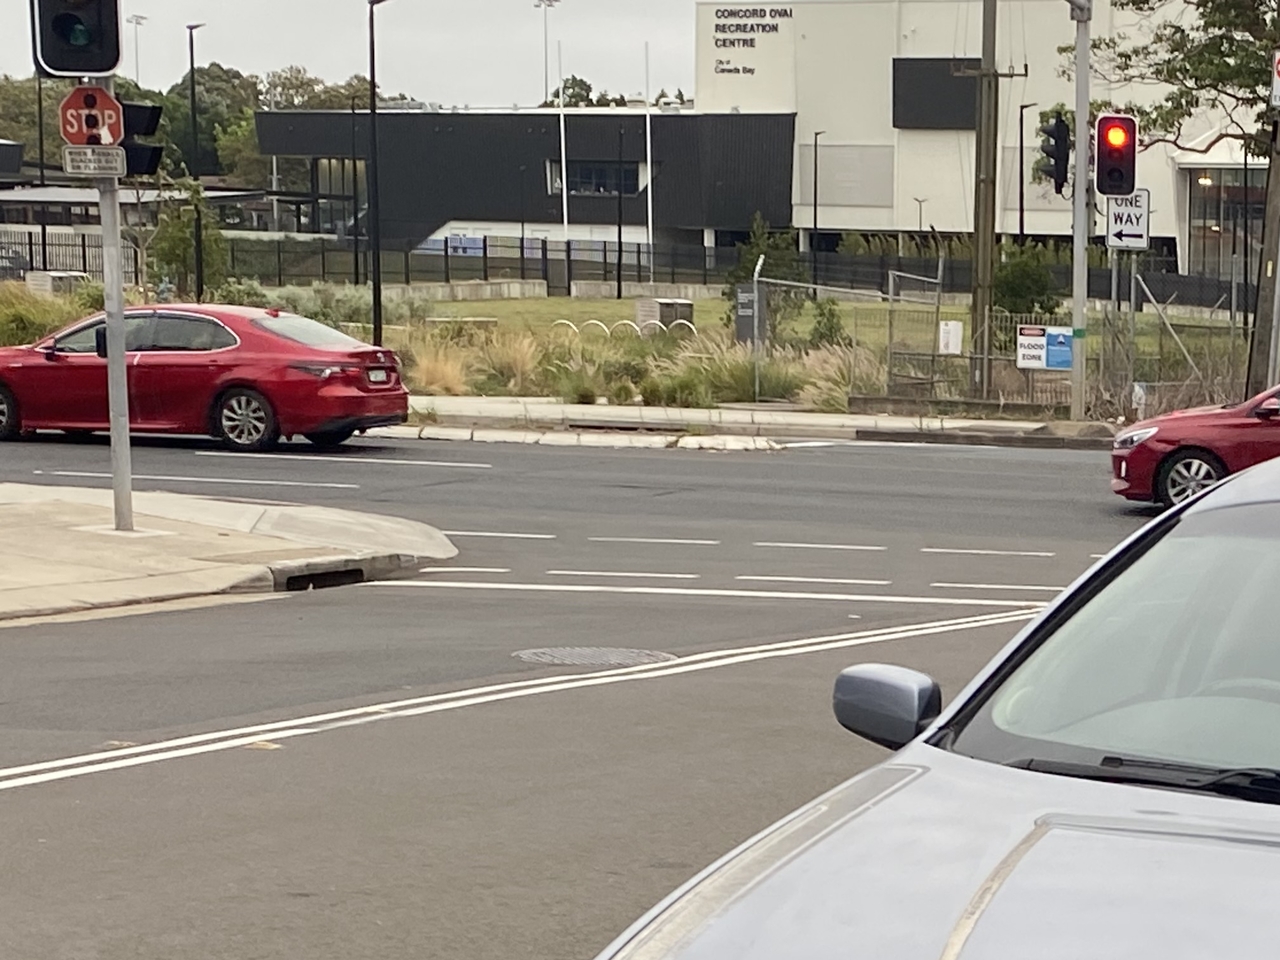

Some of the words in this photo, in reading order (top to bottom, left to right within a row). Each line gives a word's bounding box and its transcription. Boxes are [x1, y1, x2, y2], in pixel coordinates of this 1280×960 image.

[715, 9, 767, 18] CONCORD
[715, 23, 779, 33] RECREATION
[714, 38, 756, 48] CENTRE
[742, 66, 755, 76] Bay
[65, 108, 117, 134] STOP
[1114, 195, 1142, 208] ONE
[1113, 211, 1143, 226] WAY
[1022, 353, 1041, 361] ZONE
